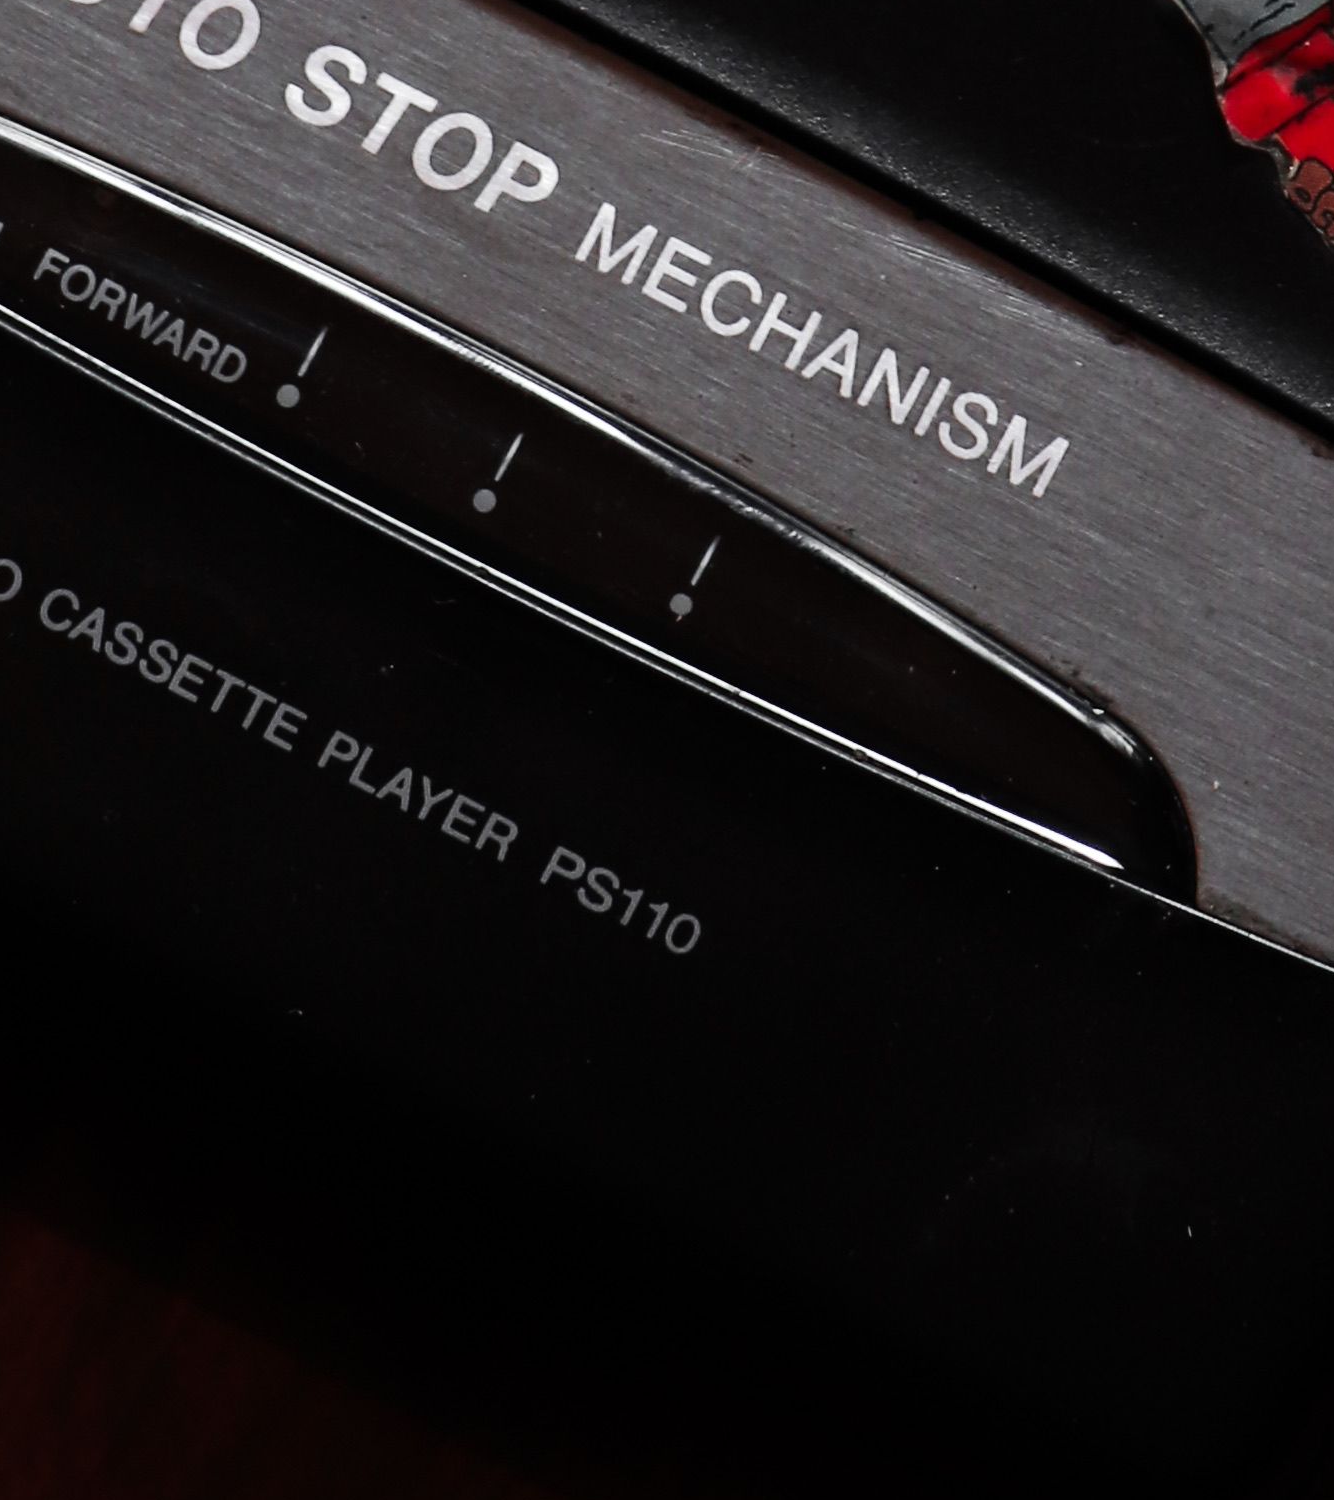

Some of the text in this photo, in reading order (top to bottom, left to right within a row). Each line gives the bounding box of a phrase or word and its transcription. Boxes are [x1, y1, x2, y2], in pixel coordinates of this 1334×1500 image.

[33, 248, 248, 383] FORWARD
[284, 44, 559, 213] STOP
[574, 202, 1070, 498] MECHANISM
[40, 588, 308, 751] CASSETTE
[318, 730, 519, 862] PLAYER
[540, 846, 702, 954] PS110
